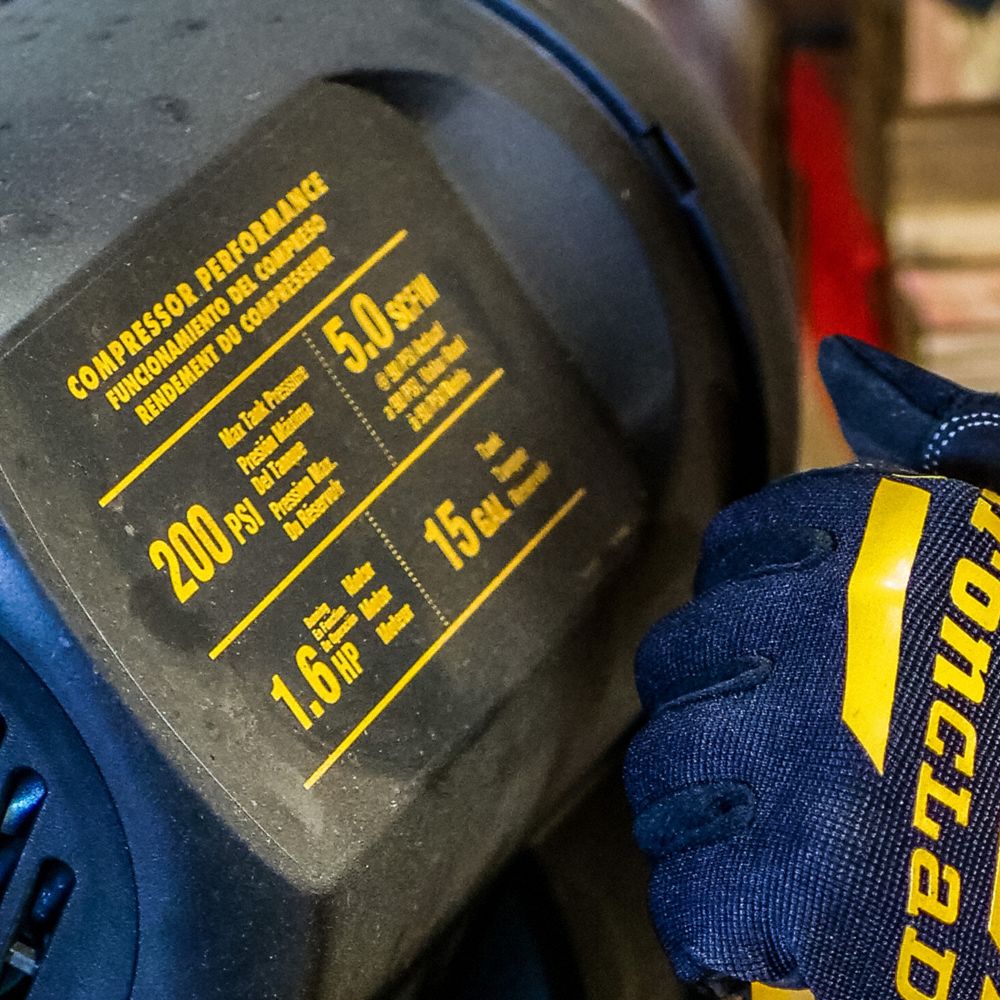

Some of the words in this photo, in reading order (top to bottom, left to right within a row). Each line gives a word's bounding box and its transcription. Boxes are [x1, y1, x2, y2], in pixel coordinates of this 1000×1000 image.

[66, 282, 200, 400] COMPRESSOR
[193, 170, 329, 293] PERFORMANCE
[105, 296, 231, 411] FUNCIONAMIENTO
[225, 273, 260, 306] DEL
[253, 213, 327, 282] COMPRESO
[134, 343, 221, 426] RENDEMENT
[214, 323, 243, 355] DU
[239, 245, 335, 334] COMPRESSEUR
[321, 292, 395, 373] 5.0
[217, 422, 248, 449] Max
[261, 365, 310, 410] Pressure
[250, 467, 275, 497] Del
[268, 475, 316, 522] Pression
[148, 503, 234, 604] 200
[224, 498, 266, 545] PSI
[423, 498, 481, 571] 15
[271, 641, 342, 730] 1.6
[329, 641, 364, 685] HP
